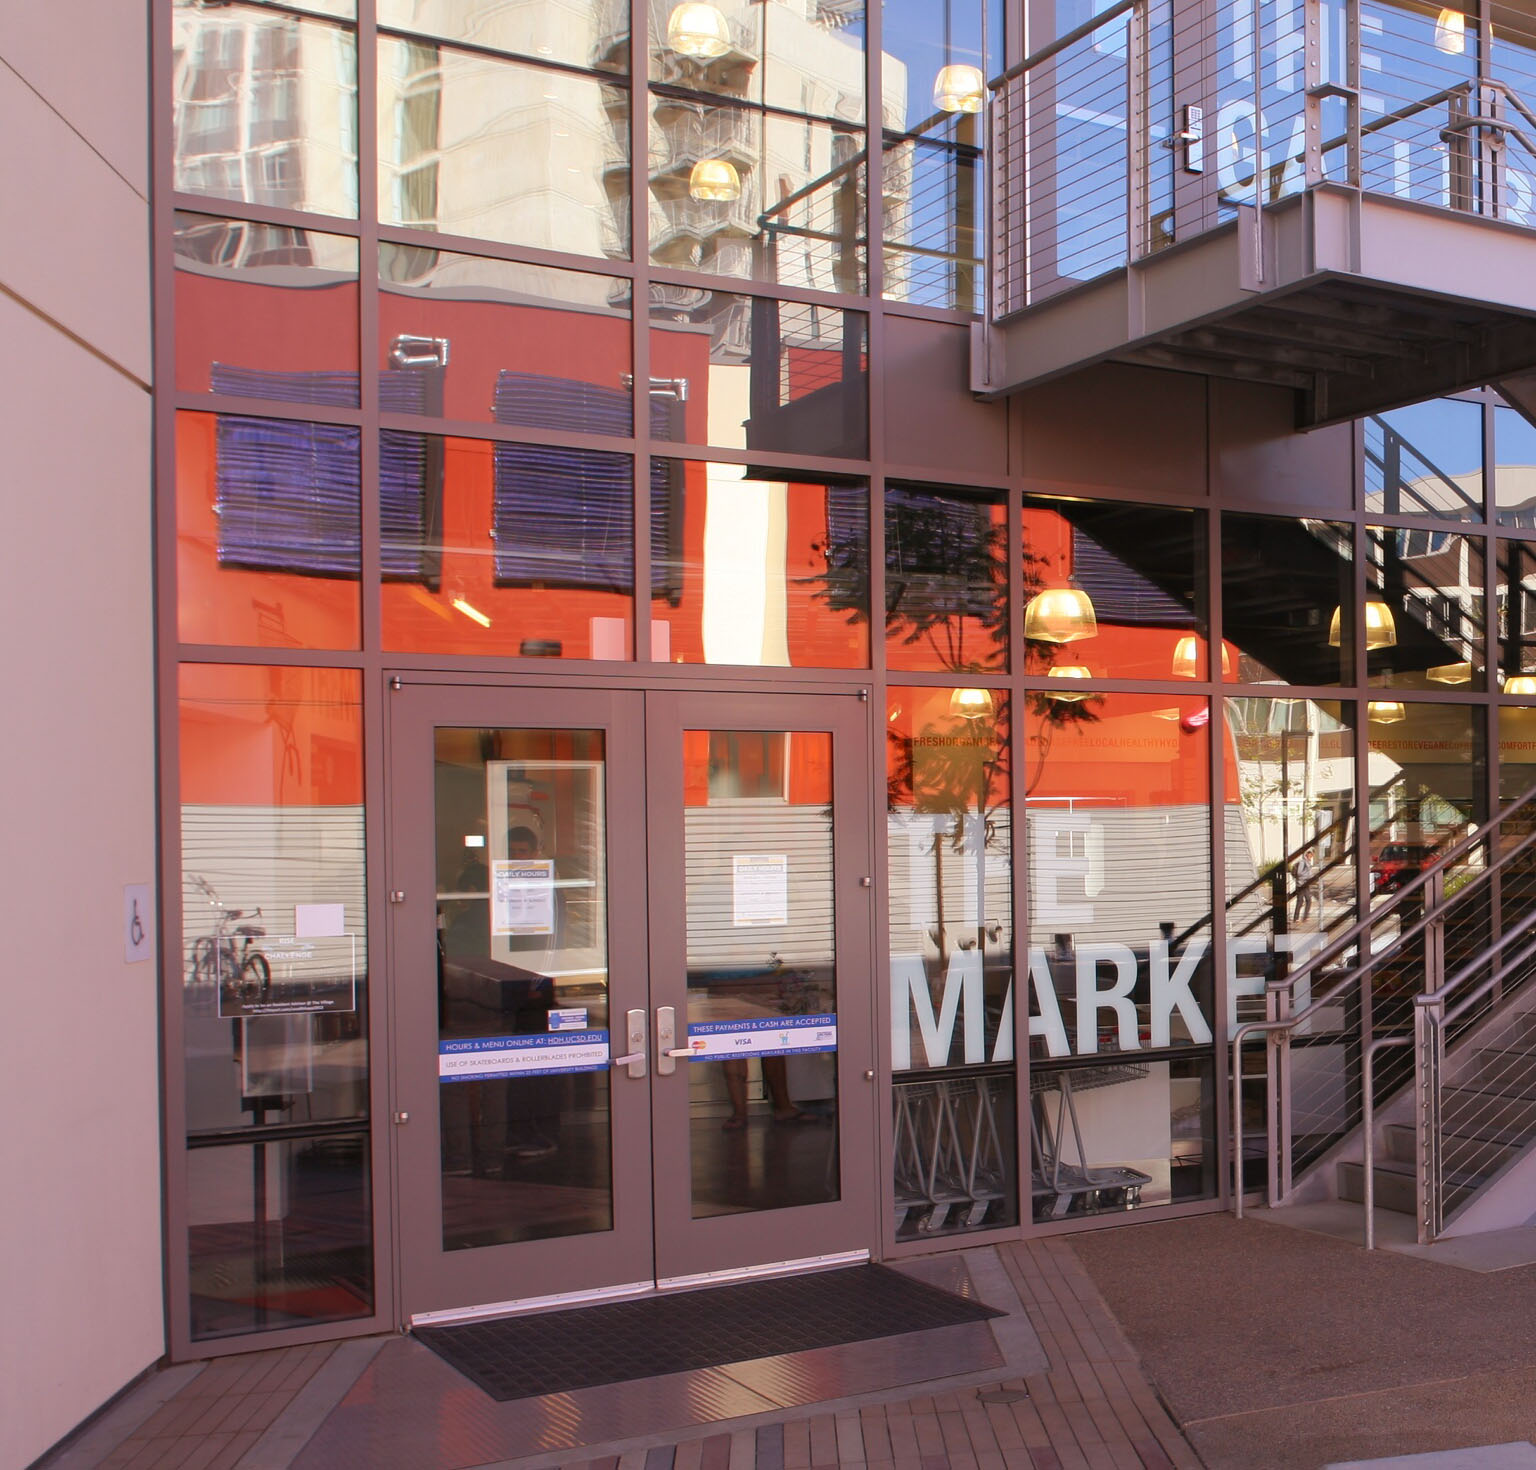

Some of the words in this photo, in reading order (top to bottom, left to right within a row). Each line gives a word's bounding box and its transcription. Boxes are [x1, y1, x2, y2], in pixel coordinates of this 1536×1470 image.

[888, 813, 1094, 931] THE
[890, 932, 1328, 1071] MARKET
[694, 1024, 714, 1033] THESE
[715, 1022, 750, 1031] PAYMENTS
[759, 1020, 779, 1029] CASH
[780, 1019, 794, 1028] ARE
[795, 1017, 831, 1026] ACCEPTED
[446, 1043, 473, 1051] HOURS
[482, 1040, 505, 1049] MENU
[506, 1038, 534, 1047] ONLINE
[734, 1038, 752, 1046] VISA
[470, 1056, 514, 1066] SKATEBOARDS
[522, 1053, 568, 1063] ROLLERBLADES
[568, 1050, 604, 1059] PROHIBITED
